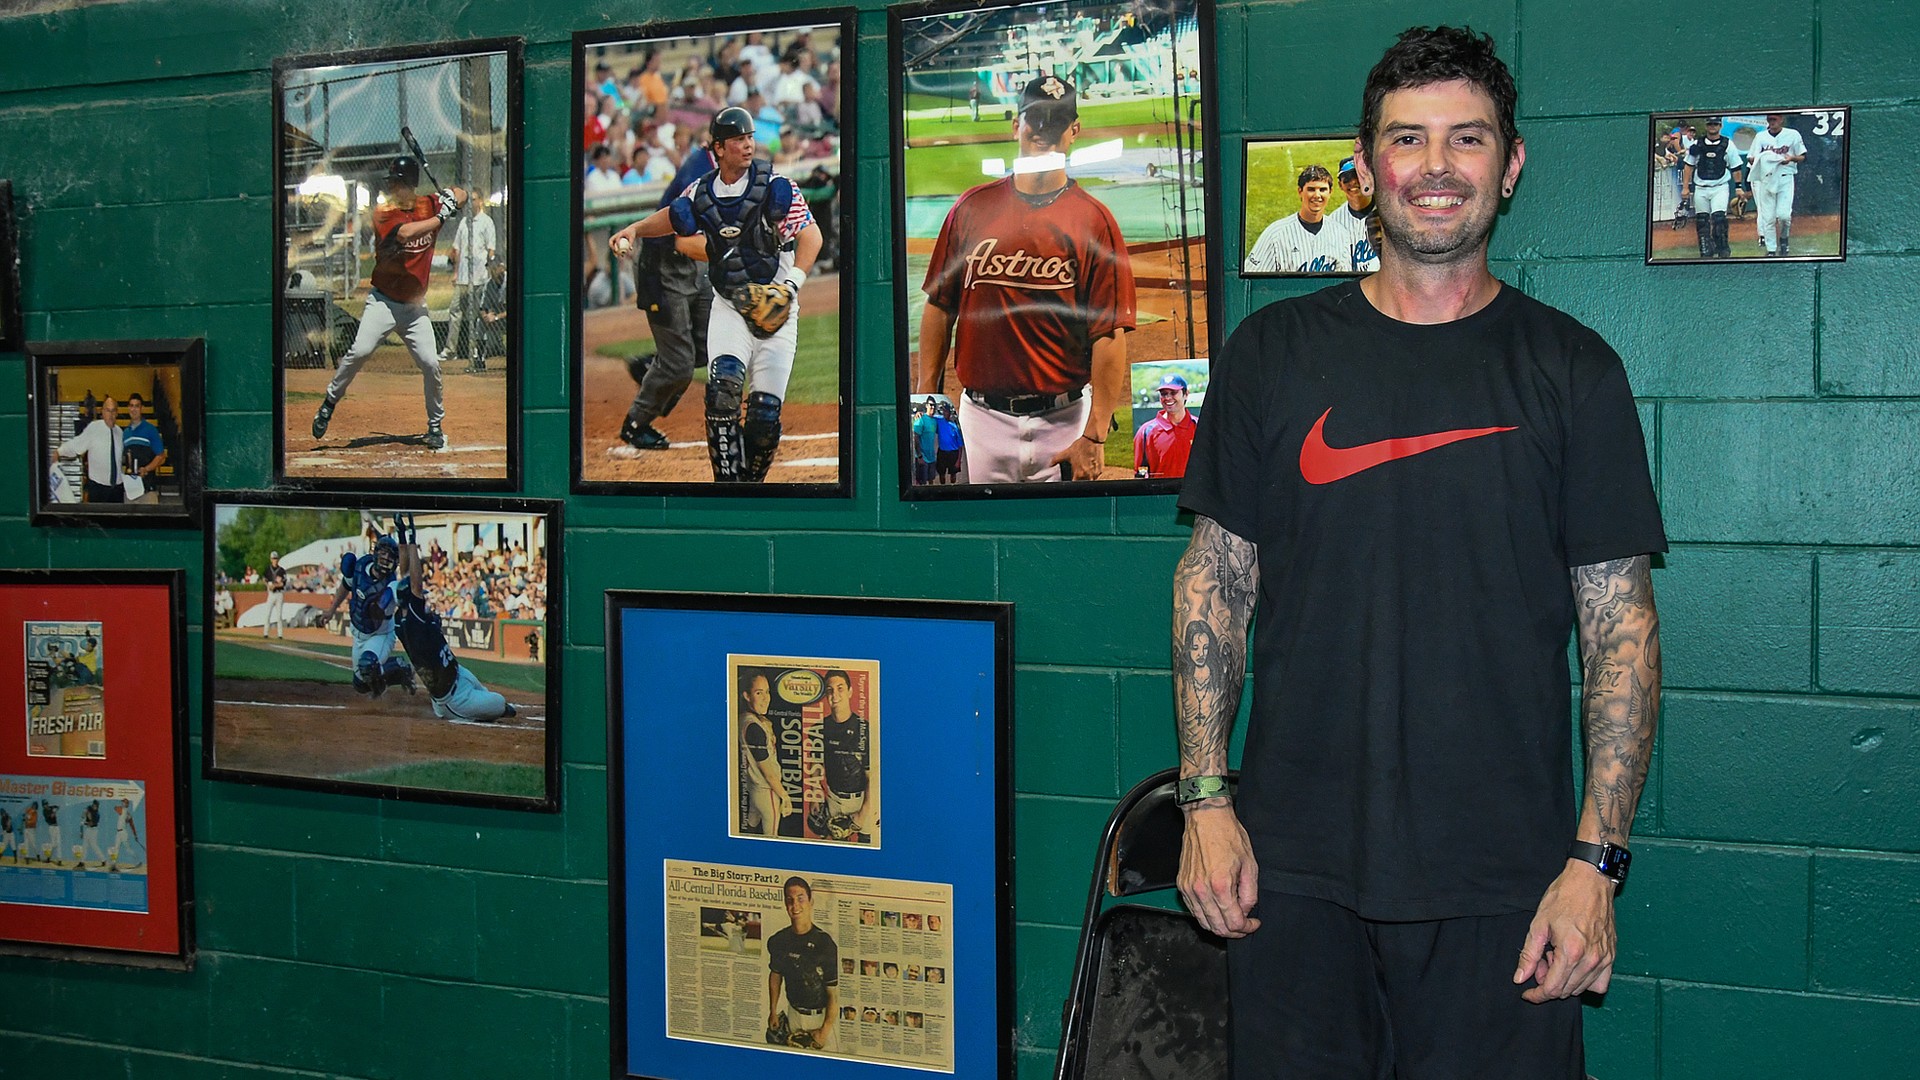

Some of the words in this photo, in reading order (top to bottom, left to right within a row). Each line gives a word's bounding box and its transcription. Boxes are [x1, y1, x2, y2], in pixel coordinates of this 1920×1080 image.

[1813, 111, 1844, 136] 32
[964, 238, 1077, 288] Astros
[718, 426, 730, 476] EASTON
[782, 679, 820, 696] Varsity
[30, 714, 75, 735] FRESH
[78, 711, 103, 731] AIR
[802, 702, 825, 803] BASEBALL
[781, 718, 803, 814] SOFTBALL
[52, 781, 114, 798] Blasters
[692, 866, 709, 878] The
[710, 868, 725, 881] Big
[726, 870, 753, 882] Story:
[754, 872, 773, 883] Part
[774, 875, 779, 883] 2
[668, 880, 715, 895] All-Central
[717, 884, 747, 898] Florida
[750, 887, 783, 902] Baseball
